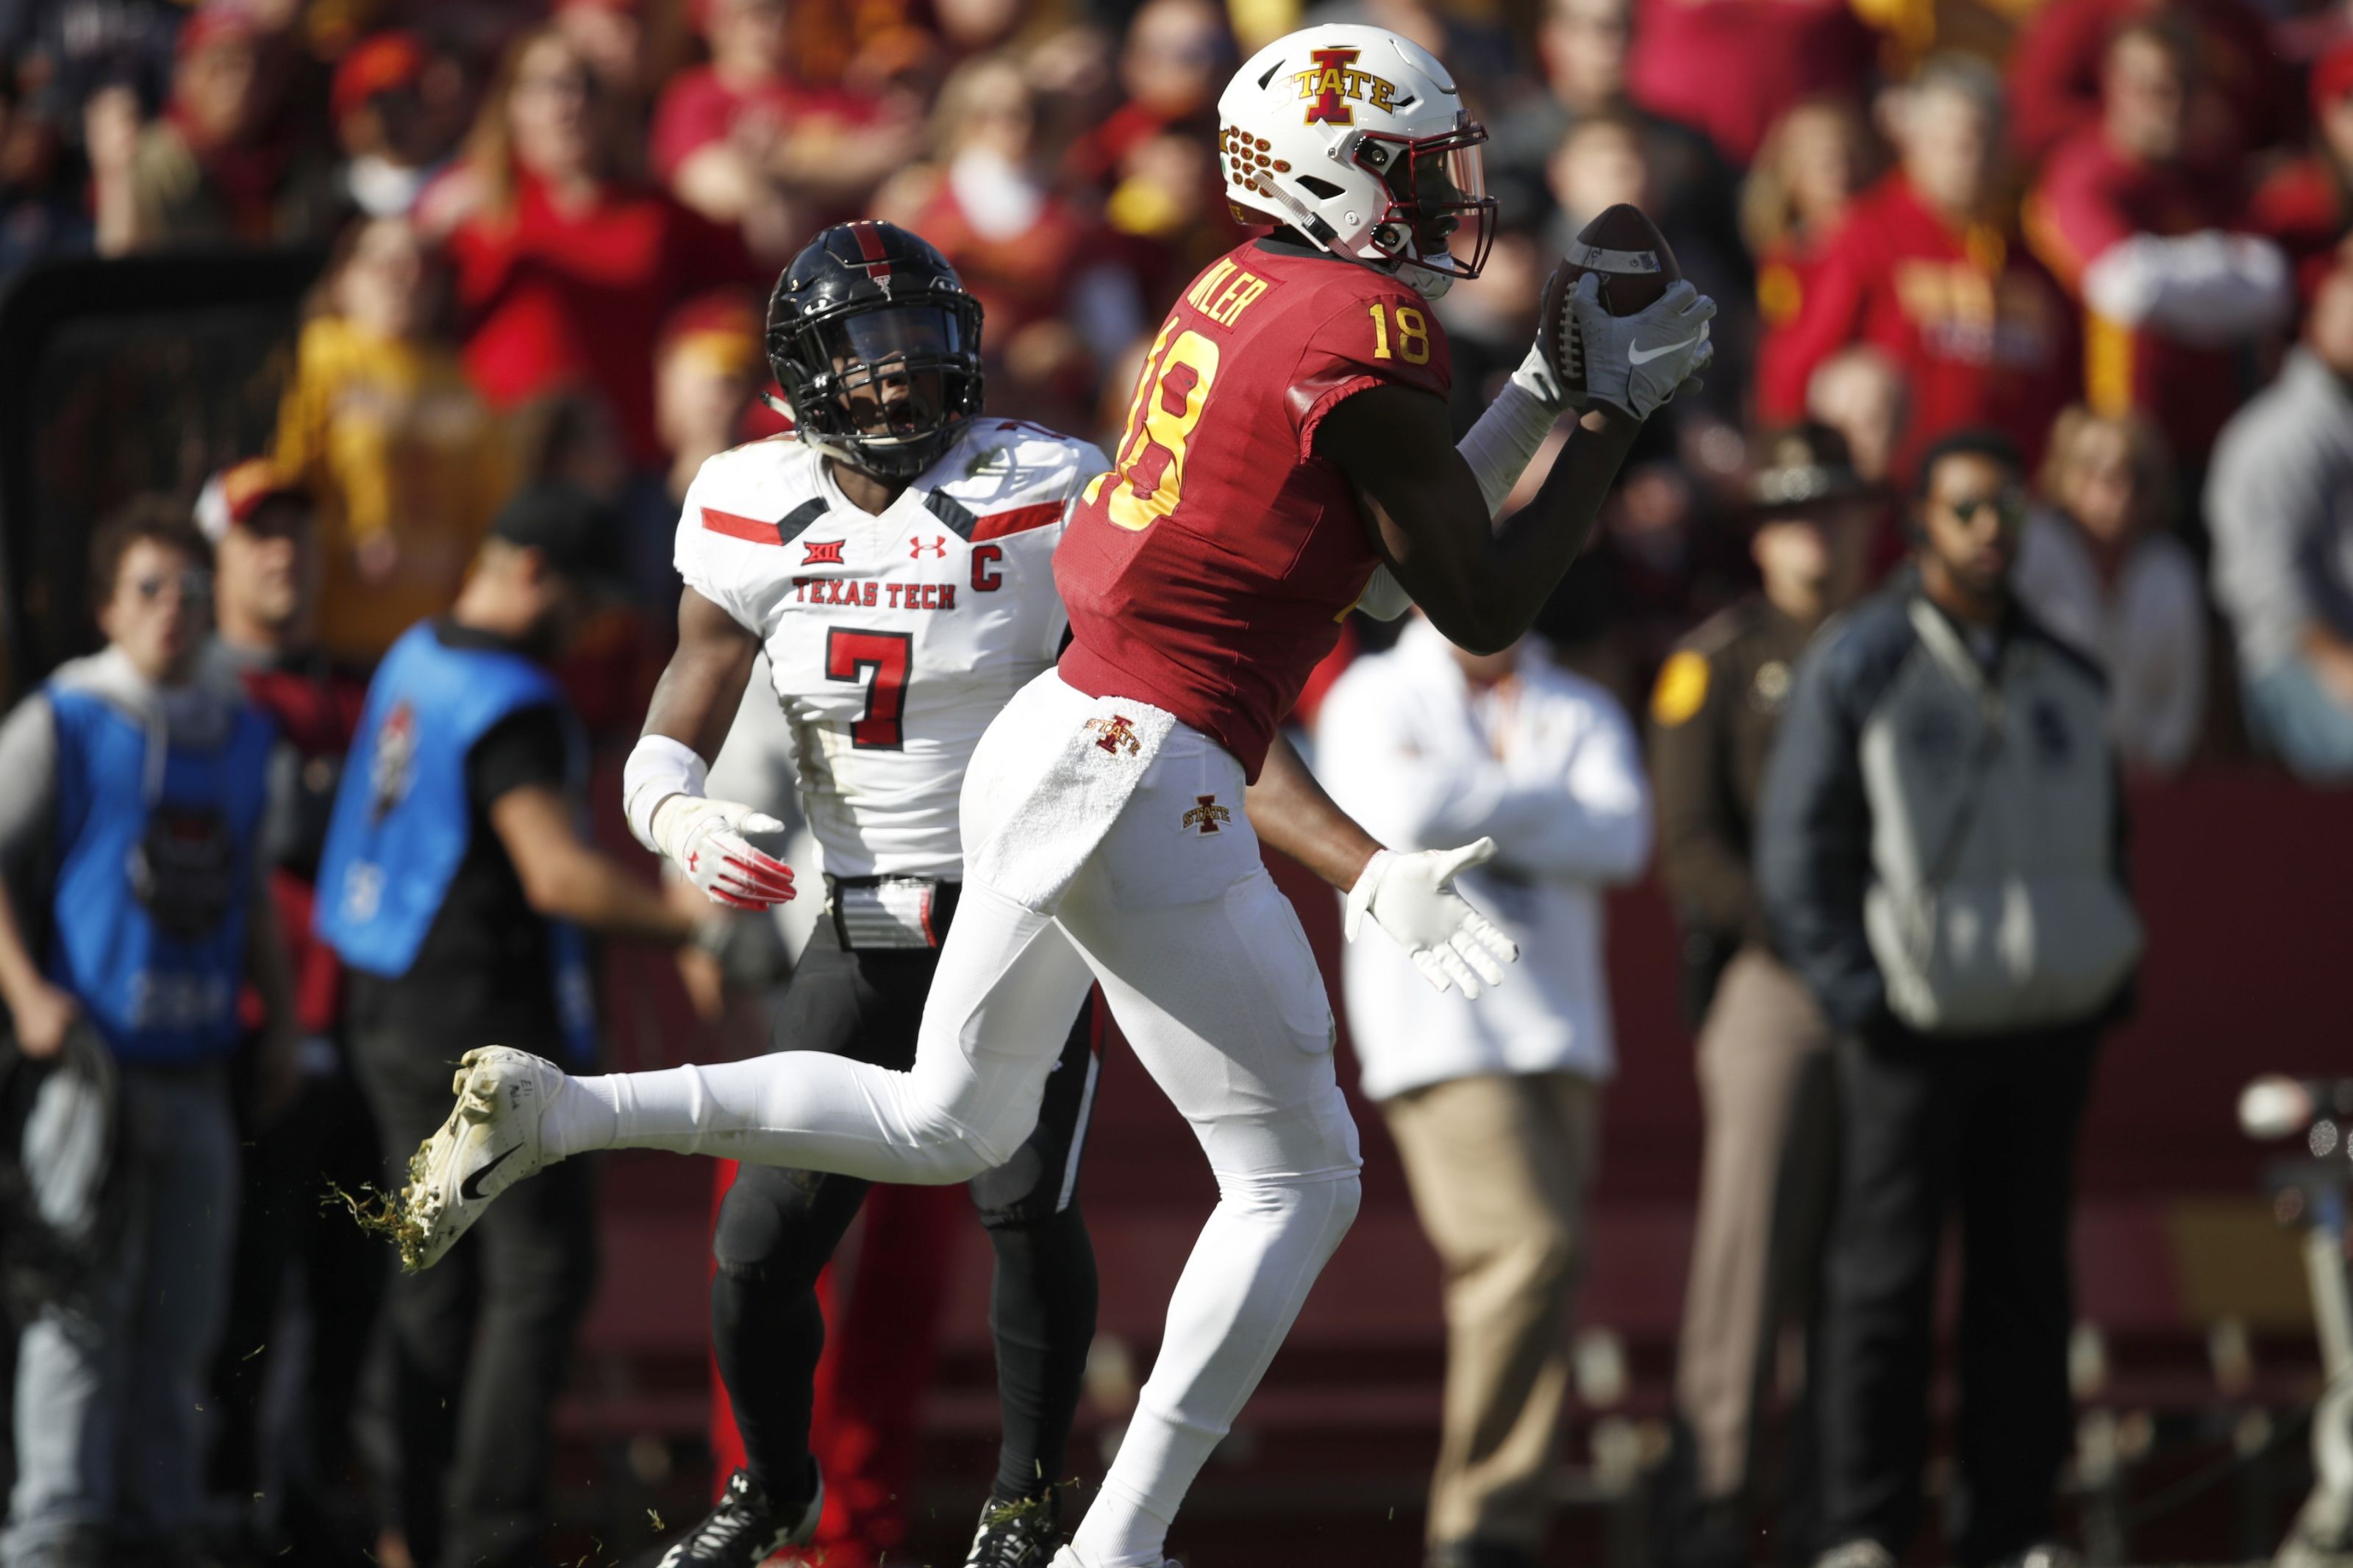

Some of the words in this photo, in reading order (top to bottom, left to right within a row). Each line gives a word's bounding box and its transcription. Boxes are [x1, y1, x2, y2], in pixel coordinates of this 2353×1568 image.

[1368, 303, 1429, 365] 18
[1082, 316, 1221, 532] 18
[801, 540, 846, 565] XII
[971, 545, 1002, 592] C
[792, 577, 879, 606] TEXAS
[886, 584, 956, 609] TECH
[825, 626, 913, 751] 7
[1084, 718, 1141, 756] STATE
[1182, 806, 1231, 828] STATE
